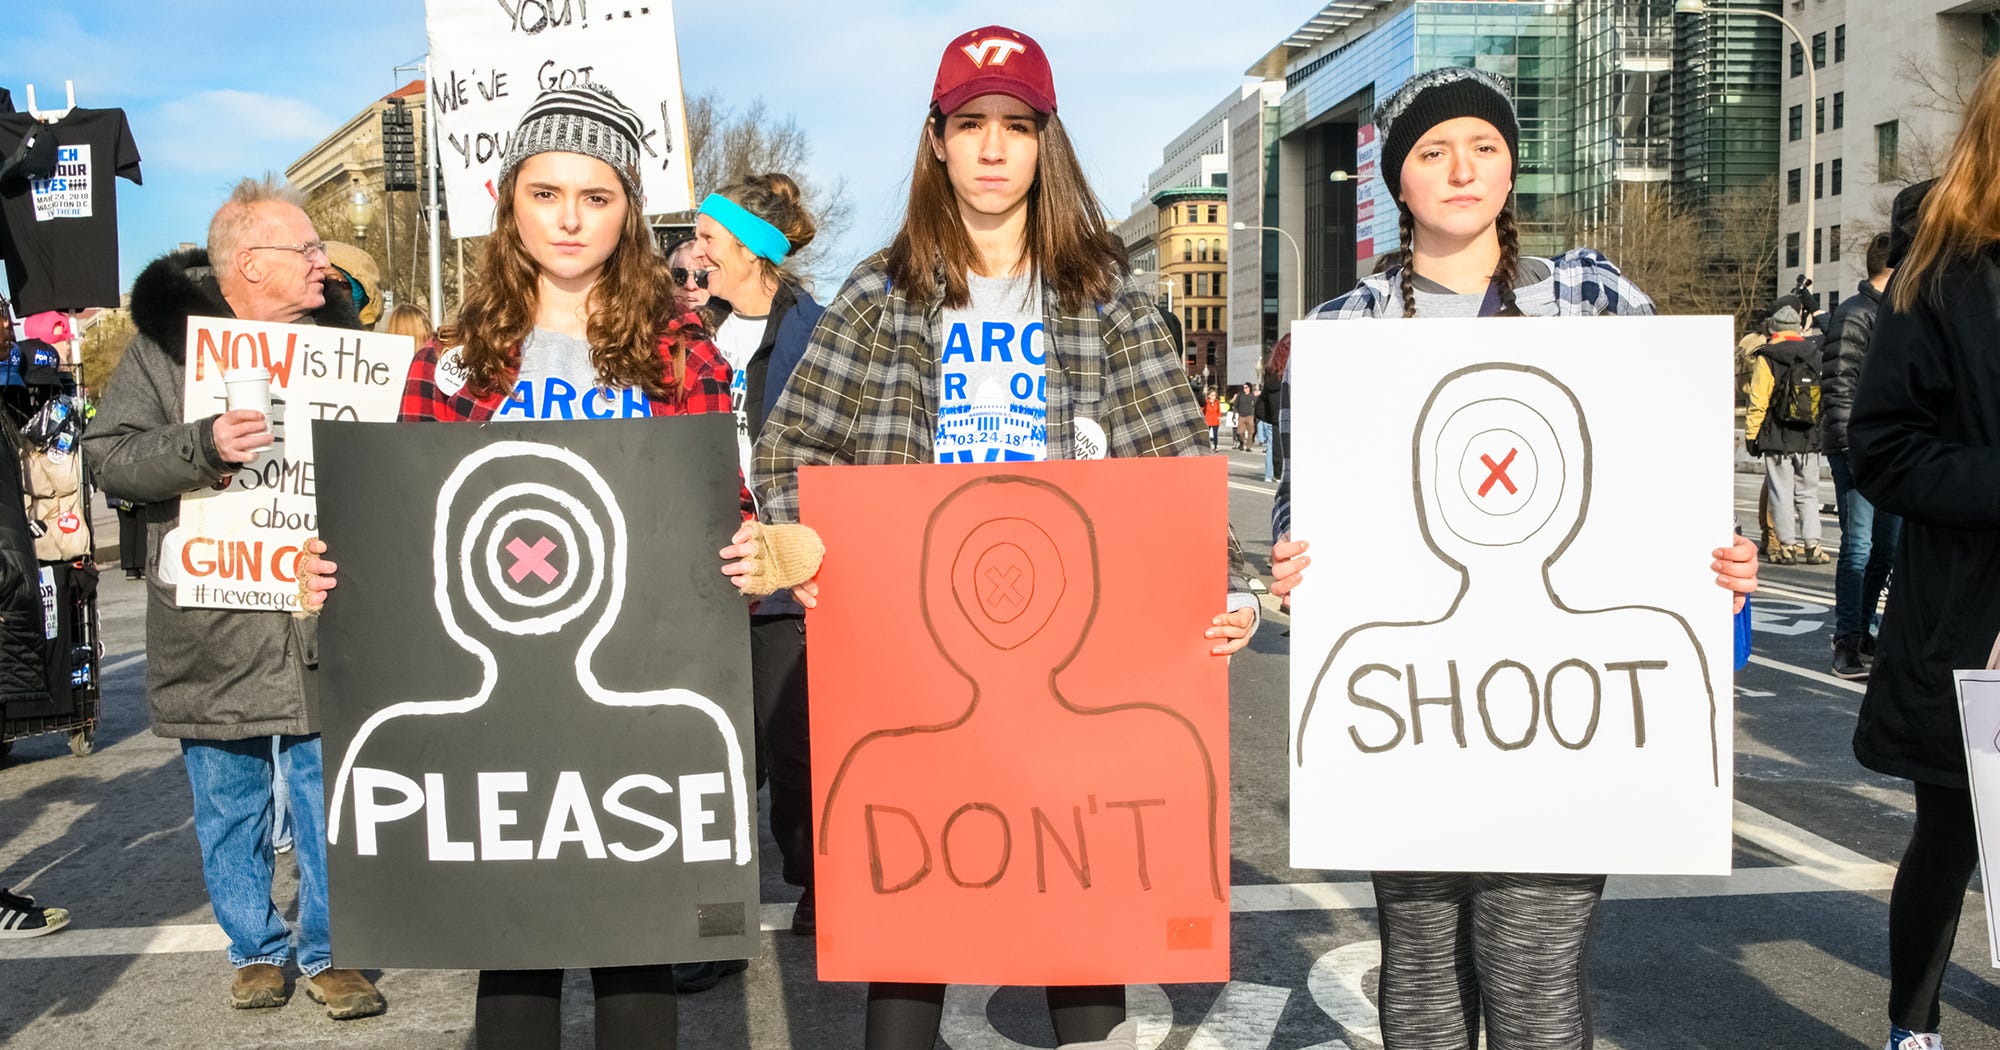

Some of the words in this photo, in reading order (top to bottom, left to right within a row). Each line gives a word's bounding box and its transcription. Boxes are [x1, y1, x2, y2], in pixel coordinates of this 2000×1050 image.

[960, 37, 1027, 69] VT
[432, 70, 509, 114] WE'VE
[196, 328, 297, 388] NOW
[303, 344, 327, 378] is
[334, 337, 390, 386] the
[499, 378, 652, 420] ARCH
[957, 431, 1021, 446] 03.24.18
[182, 537, 263, 581] GUN
[1347, 658, 1668, 753] SHOOT
[352, 767, 731, 863] PLEASE
[865, 794, 1165, 894] DON'T
